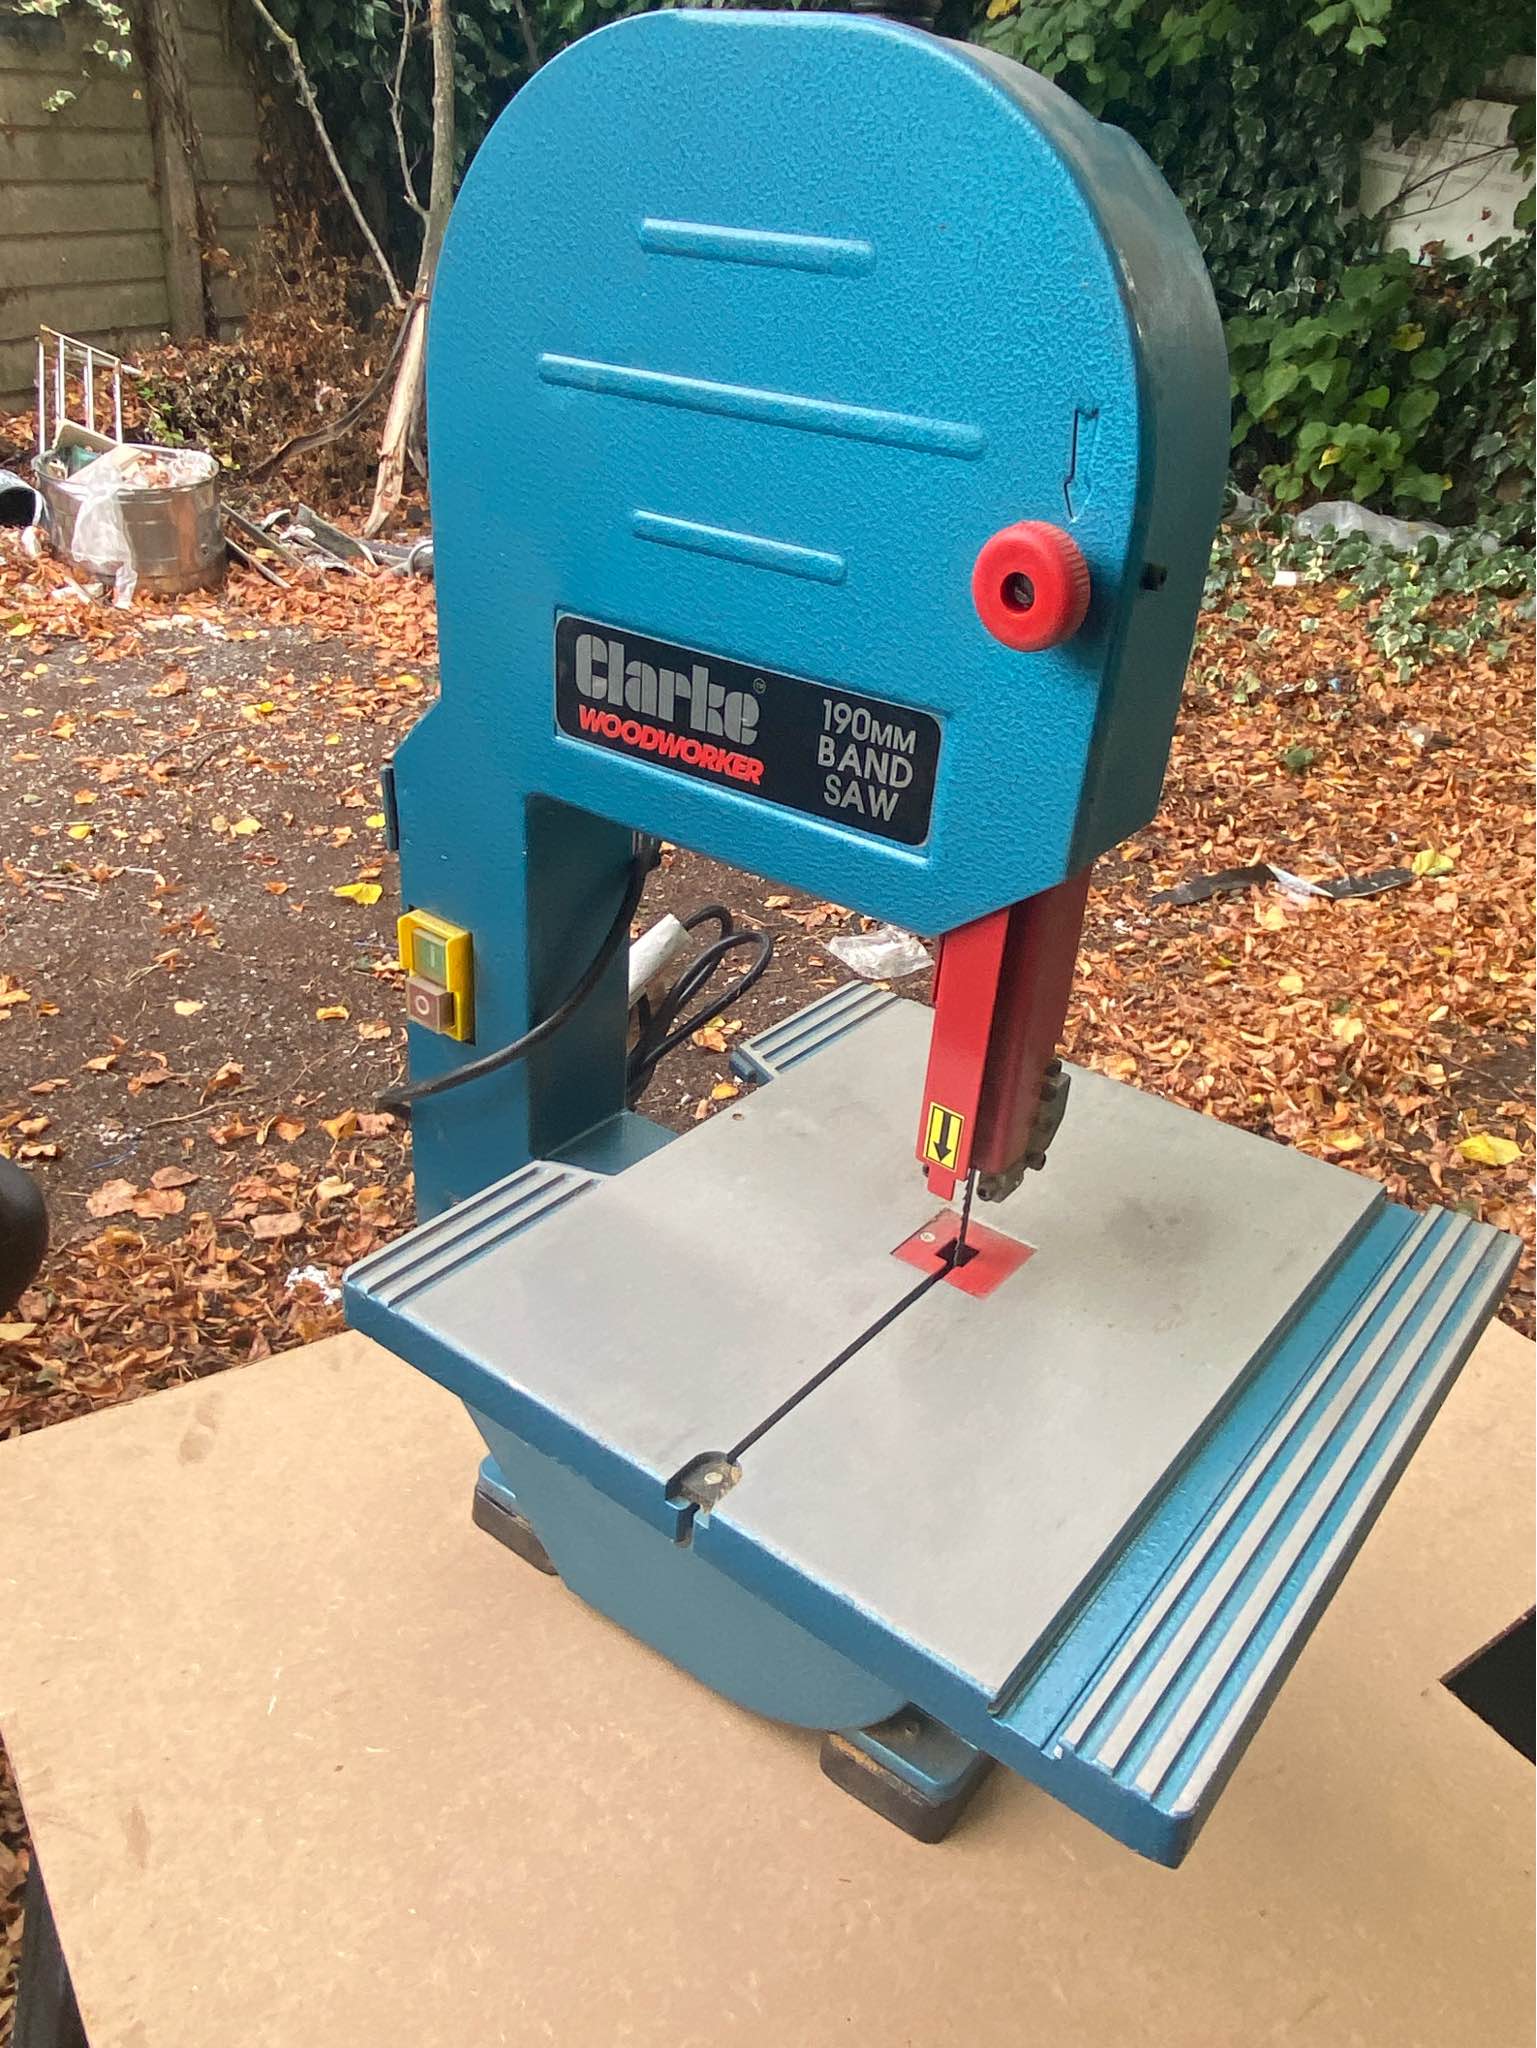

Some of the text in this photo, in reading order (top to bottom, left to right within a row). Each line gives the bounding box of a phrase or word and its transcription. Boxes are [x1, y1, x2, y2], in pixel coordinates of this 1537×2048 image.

[575, 633, 760, 746] Clarke
[578, 704, 765, 786] WOODWORKER
[823, 699, 917, 755] 190MM
[817, 734, 914, 790] BAND
[823, 773, 900, 823] SAW
